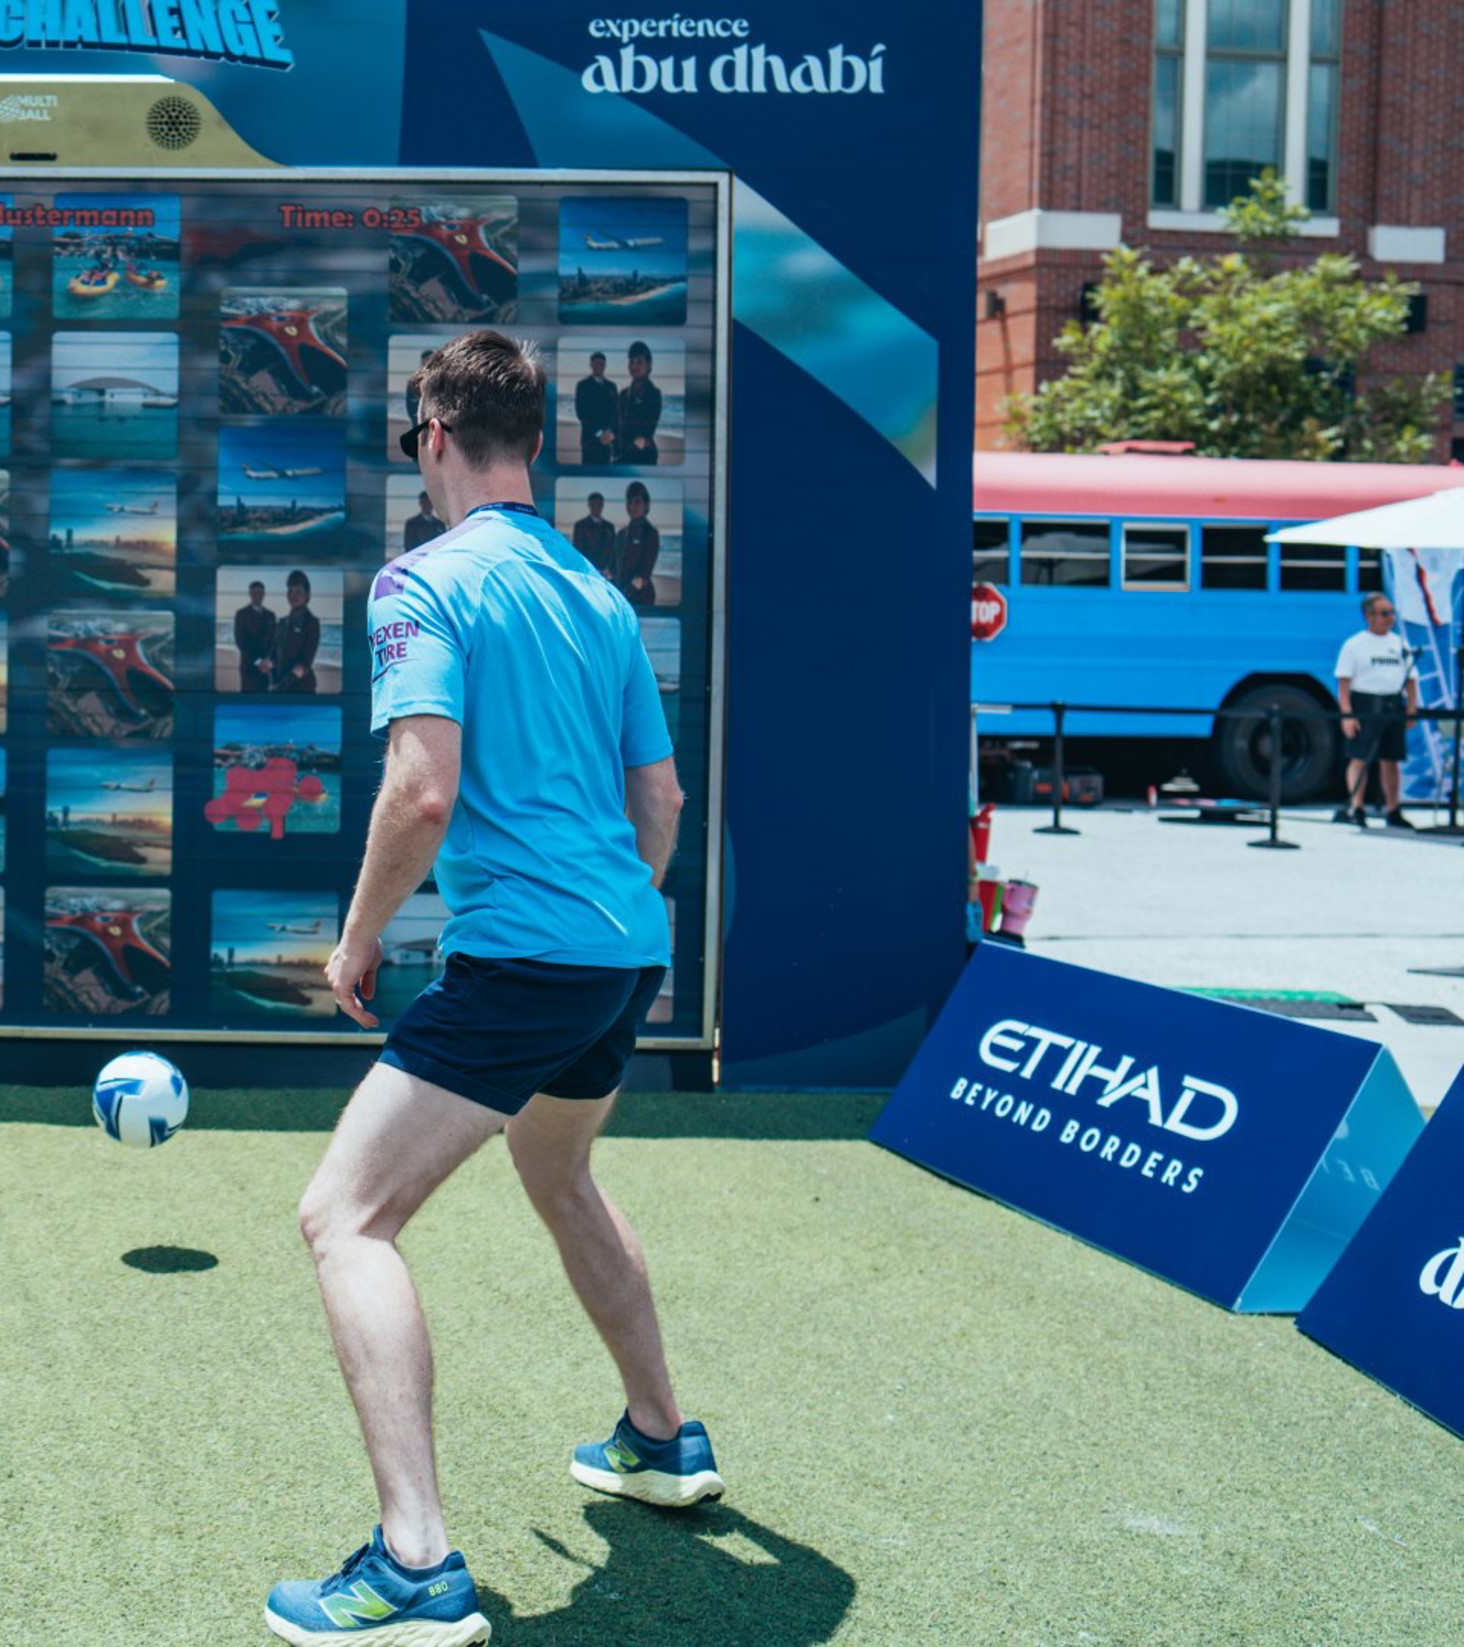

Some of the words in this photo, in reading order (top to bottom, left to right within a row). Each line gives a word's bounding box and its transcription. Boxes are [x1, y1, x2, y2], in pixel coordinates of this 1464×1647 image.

[582, 43, 698, 94] abu
[279, 205, 354, 229] Time:
[362, 207, 422, 230] 0:25
[972, 600, 1002, 625] TOP
[375, 641, 408, 668] TIRE
[979, 1018, 1239, 1142] ETIHAD
[949, 1077, 1052, 1133] BEYOND
[1059, 1118, 1204, 1194] BORDERS
